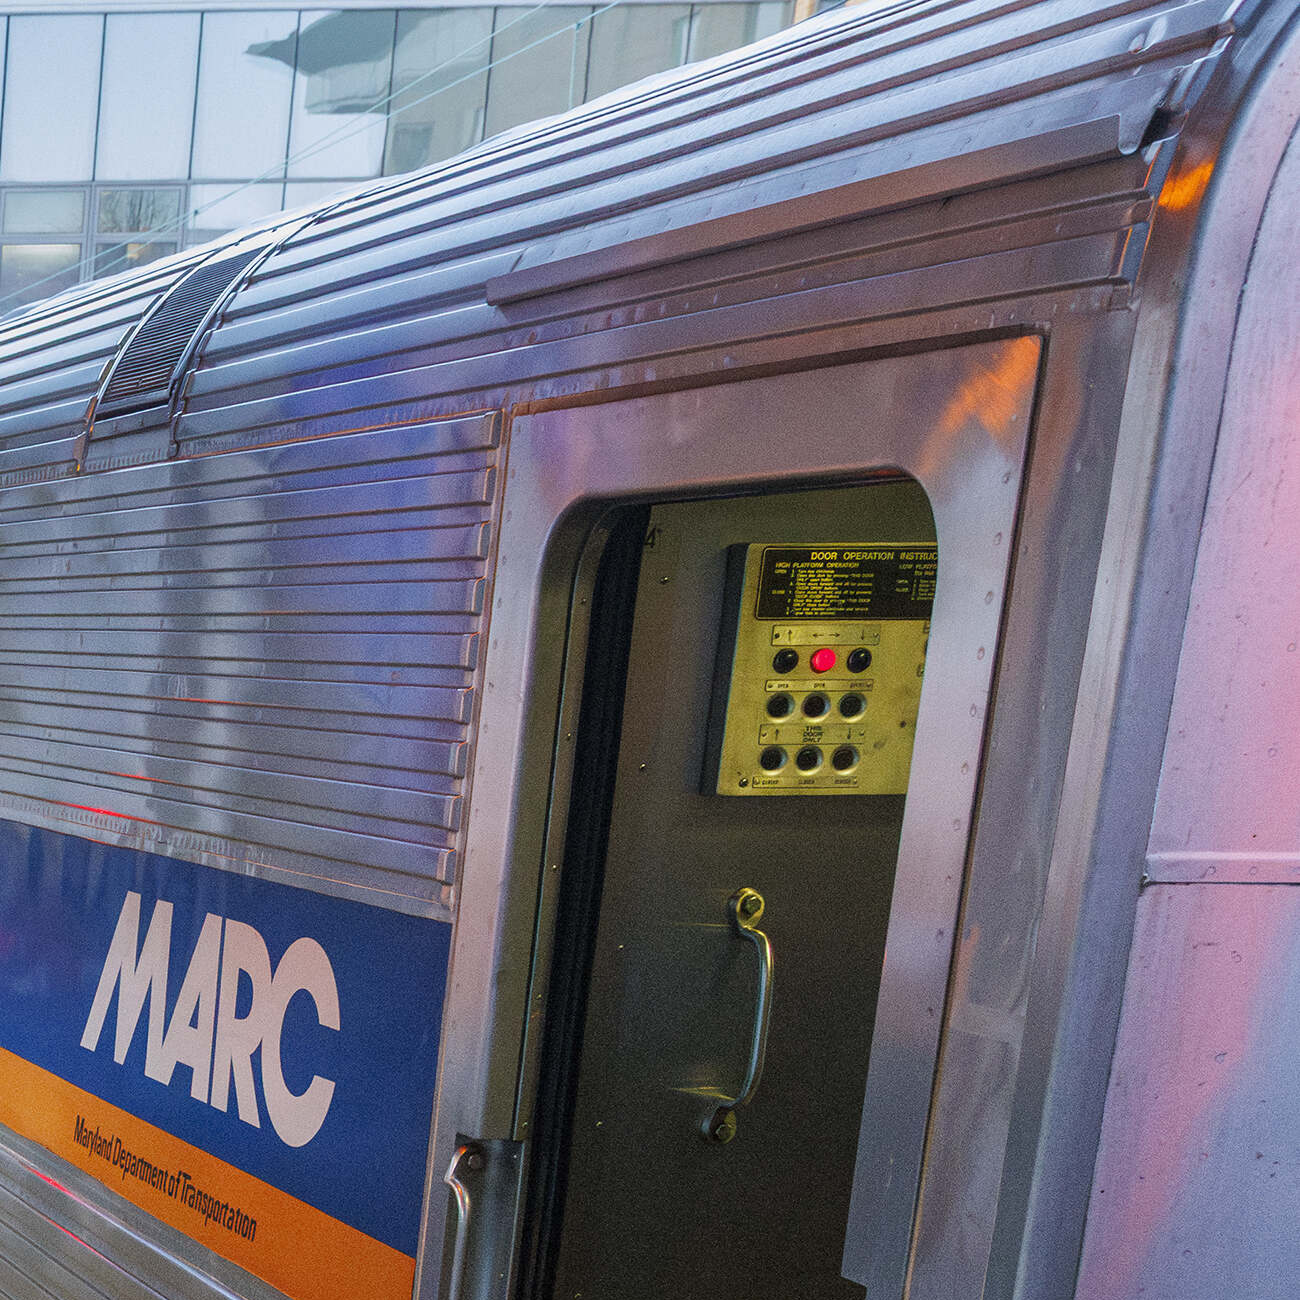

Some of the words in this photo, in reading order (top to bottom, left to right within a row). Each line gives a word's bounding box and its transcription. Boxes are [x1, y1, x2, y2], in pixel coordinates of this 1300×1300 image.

[811, 552, 837, 560] DOOR
[843, 552, 894, 560] OPERATION
[80, 891, 340, 1148] MARC
[74, 1114, 113, 1160] Maryland
[112, 1136, 168, 1193] Department
[169, 1170, 184, 1199] of
[180, 1172, 257, 1242] Transportation
